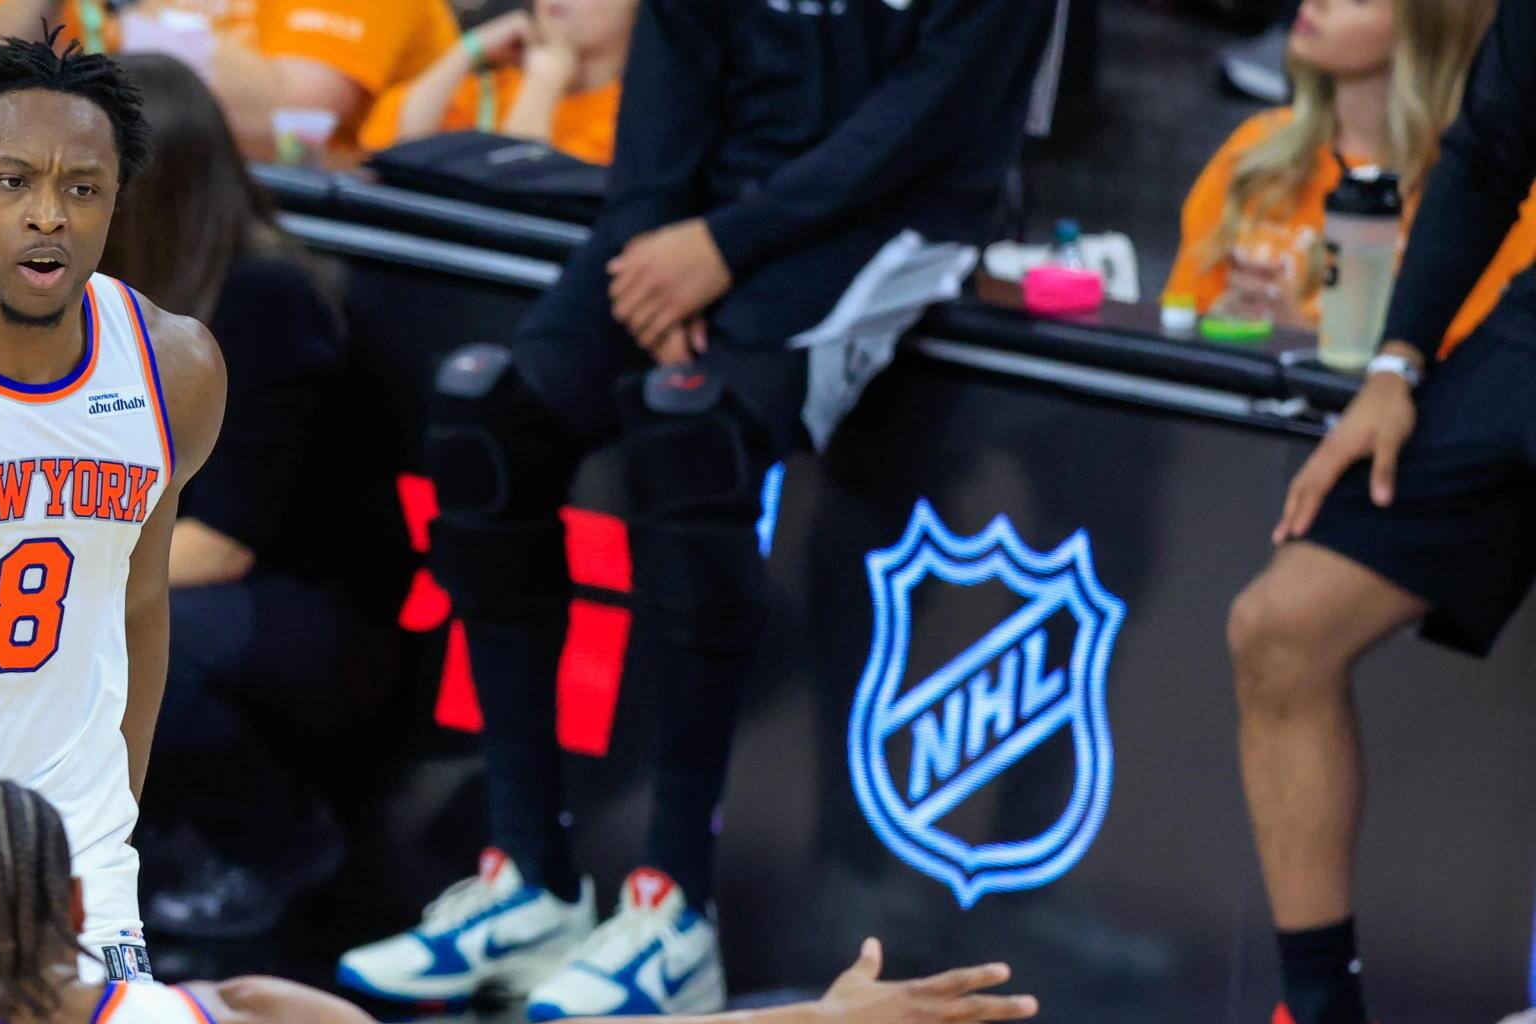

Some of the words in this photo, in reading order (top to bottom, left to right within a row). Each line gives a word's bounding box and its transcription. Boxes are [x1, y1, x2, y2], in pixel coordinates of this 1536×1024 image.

[88, 393, 119, 401] experience
[88, 401, 111, 414] abu
[113, 395, 145, 411] dhabi
[39, 456, 161, 524] YORK
[908, 626, 1065, 801] NHL
